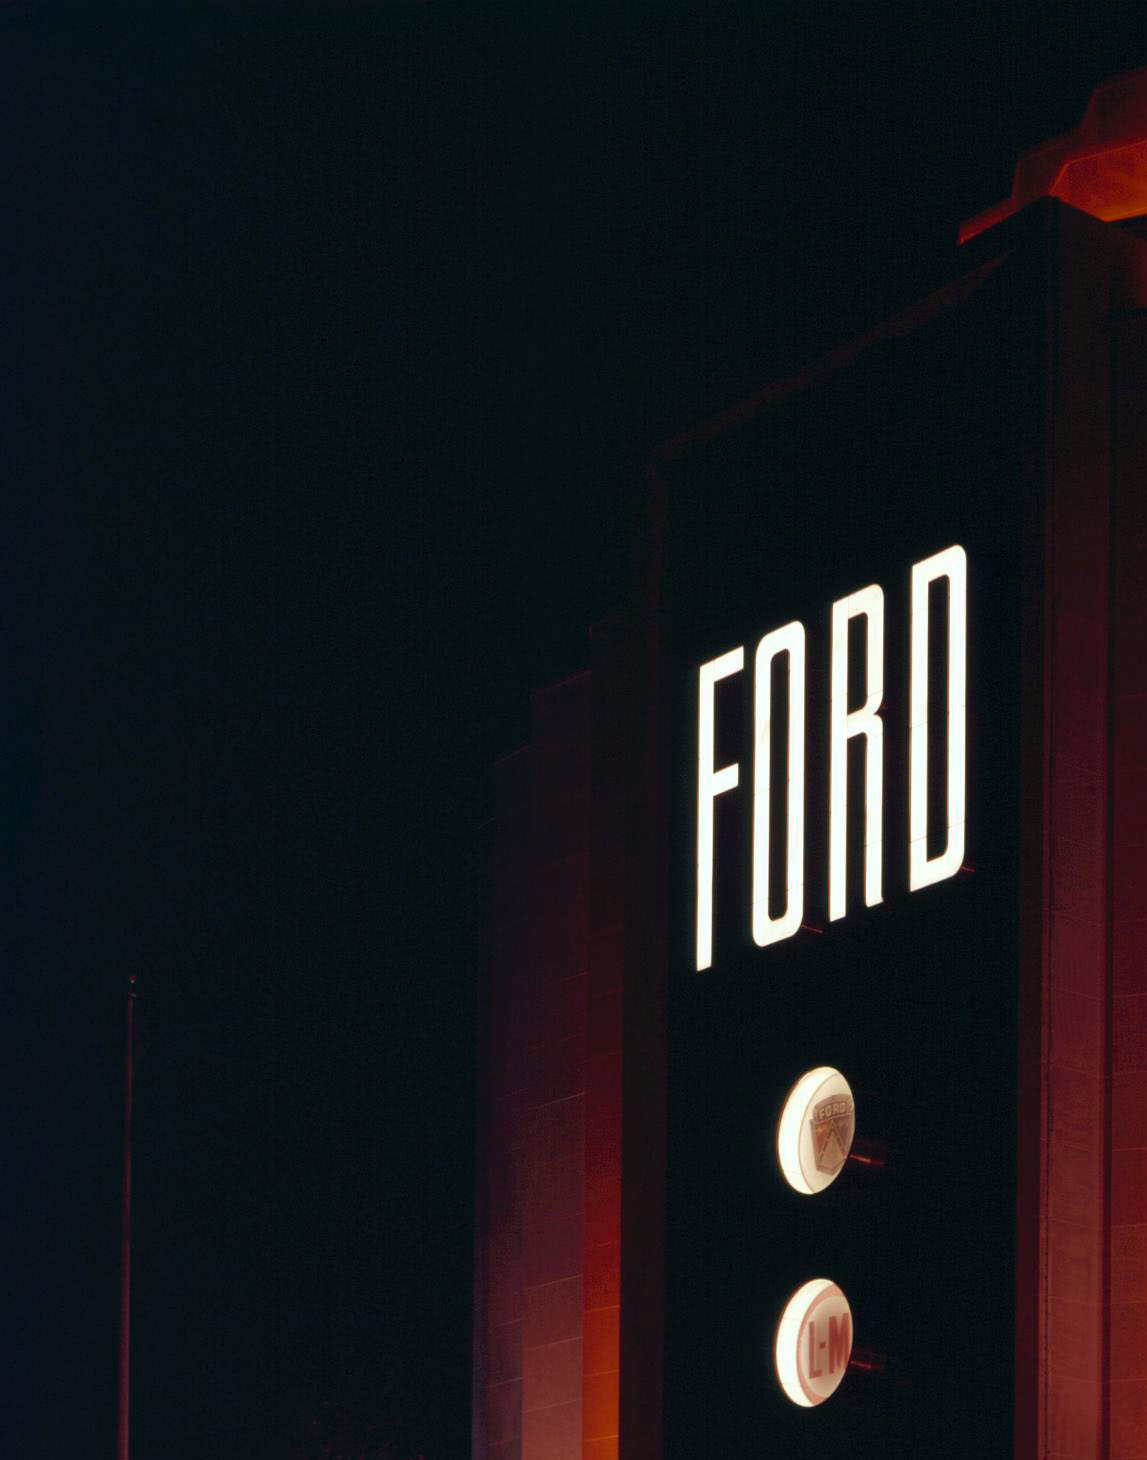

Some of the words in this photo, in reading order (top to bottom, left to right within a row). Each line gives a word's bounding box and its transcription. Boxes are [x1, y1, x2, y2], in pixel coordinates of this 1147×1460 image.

[697, 544, 967, 972] FORD
[819, 1101, 847, 1120] FORD
[808, 1311, 851, 1379] L-M
